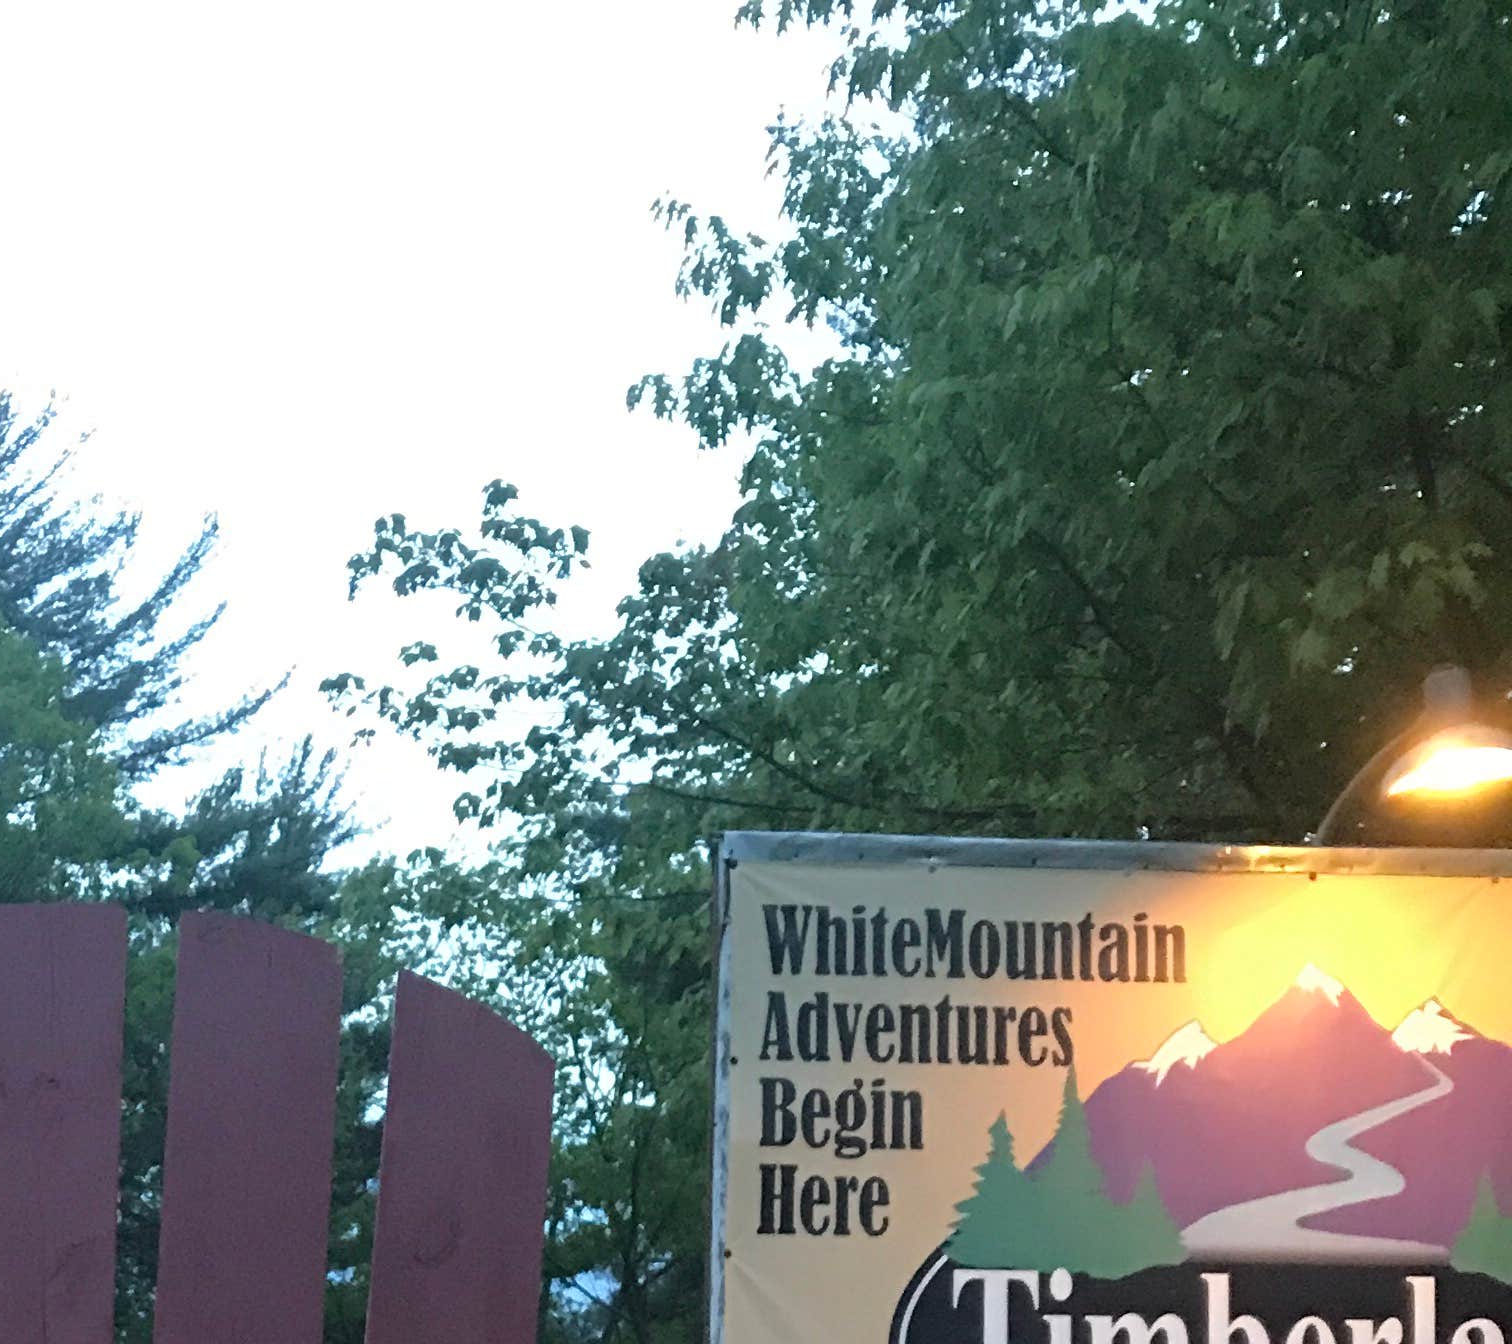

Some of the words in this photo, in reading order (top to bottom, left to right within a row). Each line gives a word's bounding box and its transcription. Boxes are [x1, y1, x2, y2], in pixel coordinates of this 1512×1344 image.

[758, 990, 1074, 1067] Adventures
[759, 1077, 924, 1159] Begin
[756, 1163, 890, 1237] Here
